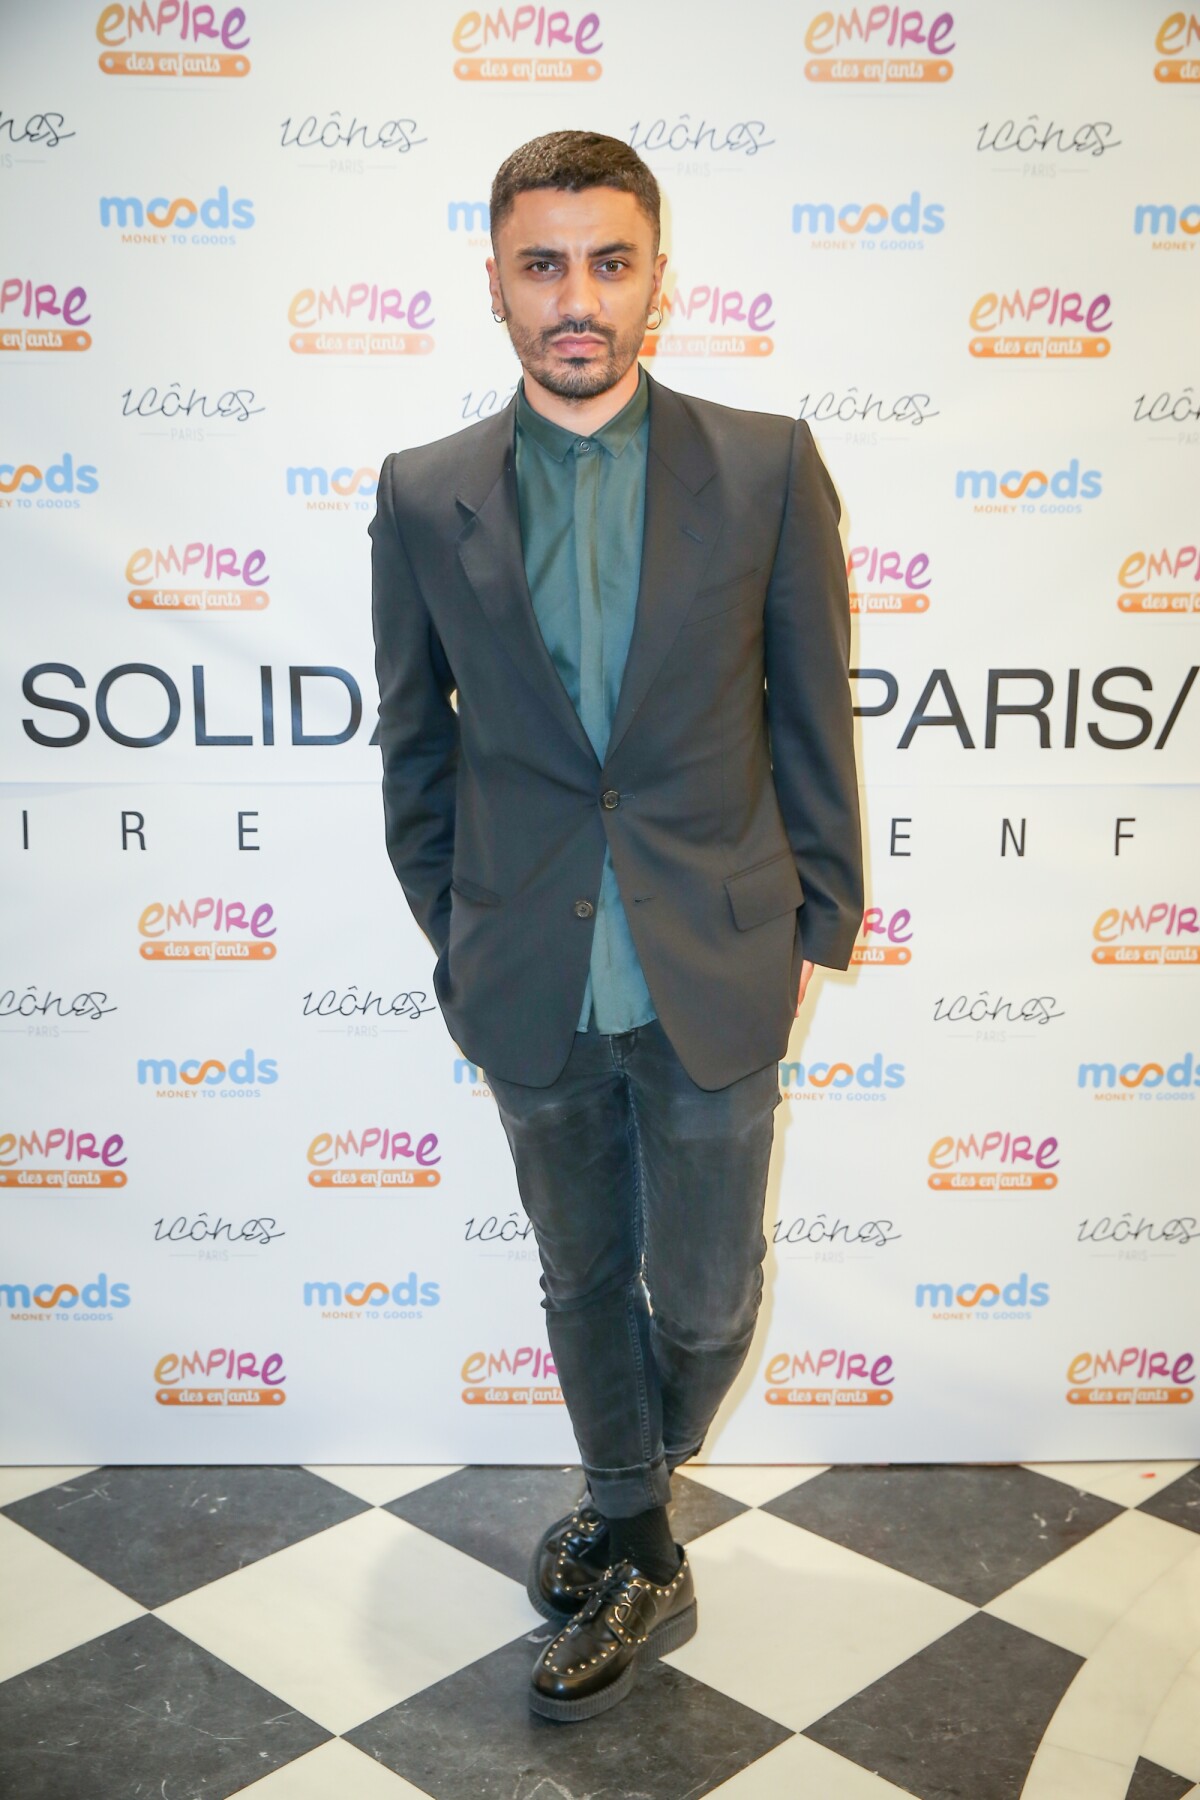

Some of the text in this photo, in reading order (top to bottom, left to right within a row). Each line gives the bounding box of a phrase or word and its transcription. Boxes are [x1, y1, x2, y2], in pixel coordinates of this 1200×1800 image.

[126, 51, 221, 75] des enfants
[480, 58, 573, 81] des enfants
[831, 59, 924, 82] des enfants
[1180, 61, 1200, 79] de
[329, 160, 365, 175] PARIS
[677, 162, 712, 177] PARIS
[1023, 163, 1057, 178] PARIS
[100, 186, 255, 230] moods
[792, 191, 945, 235] moods
[122, 235, 236, 245] MONEY TO GOODS
[811, 240, 924, 250] MONEY TO GOODS
[1152, 241, 1196, 251] MONEY
[0, 278, 91, 326] PIRe
[660, 286, 776, 332] MPIRe
[2, 329, 63, 351] enfants
[315, 333, 406, 356] des enfants
[687, 335, 746, 357] enfants
[994, 336, 1083, 358] des enfants
[170, 428, 205, 443] PARIS
[846, 432, 878, 446] PARIS
[1178, 432, 1200, 446] PAR
[0, 452, 99, 493] oods
[286, 467, 379, 496] moo
[956, 459, 1103, 498] moods
[16, 499, 32, 508] TO
[36, 499, 80, 508] GOODS
[306, 502, 350, 510] MONEY
[354, 502, 369, 510] TO
[974, 505, 1083, 514] MONEY TO GOODS
[847, 546, 932, 590] PIRe
[153, 589, 241, 611] des enfants
[1142, 594, 1168, 609] des
[22, 662, 380, 748] SOLID
[1092, 902, 1200, 942] eMPIR
[164, 941, 250, 961] des enfants
[852, 950, 885, 961] ants
[1115, 945, 1198, 965] des enfants
[0, 986, 117, 1020] cônes
[28, 1025, 60, 1038] PARIS
[347, 1025, 379, 1038] PARIS
[975, 1030, 1007, 1043] PARIS
[137, 1048, 279, 1085] moods
[156, 1089, 261, 1098] MONEY TO GOODS
[784, 1093, 887, 1101] MONEY TO GOODS
[1094, 1092, 1195, 1101] MONEY TO GOODS
[17, 1170, 101, 1188] des enfants
[332, 1169, 414, 1188] des enfants
[951, 1172, 1033, 1191] des enfants
[198, 1250, 229, 1262] PARIS
[508, 1250, 538, 1262] PARIS
[815, 1252, 845, 1263] PARIS
[1118, 1249, 1148, 1261] PARIS
[304, 1272, 441, 1307] moods
[915, 1273, 1050, 1308] moods
[11, 1313, 113, 1321] MONEY TO GOODS
[321, 1311, 423, 1319] MONEY TO GOODS
[933, 1312, 1032, 1320] MONEY TO GOODS
[461, 1347, 558, 1384] eMPIR
[179, 1388, 260, 1406] des enfants
[484, 1388, 509, 1401] des
[788, 1389, 868, 1406] des enfants
[1089, 1387, 1169, 1405] des enfants
